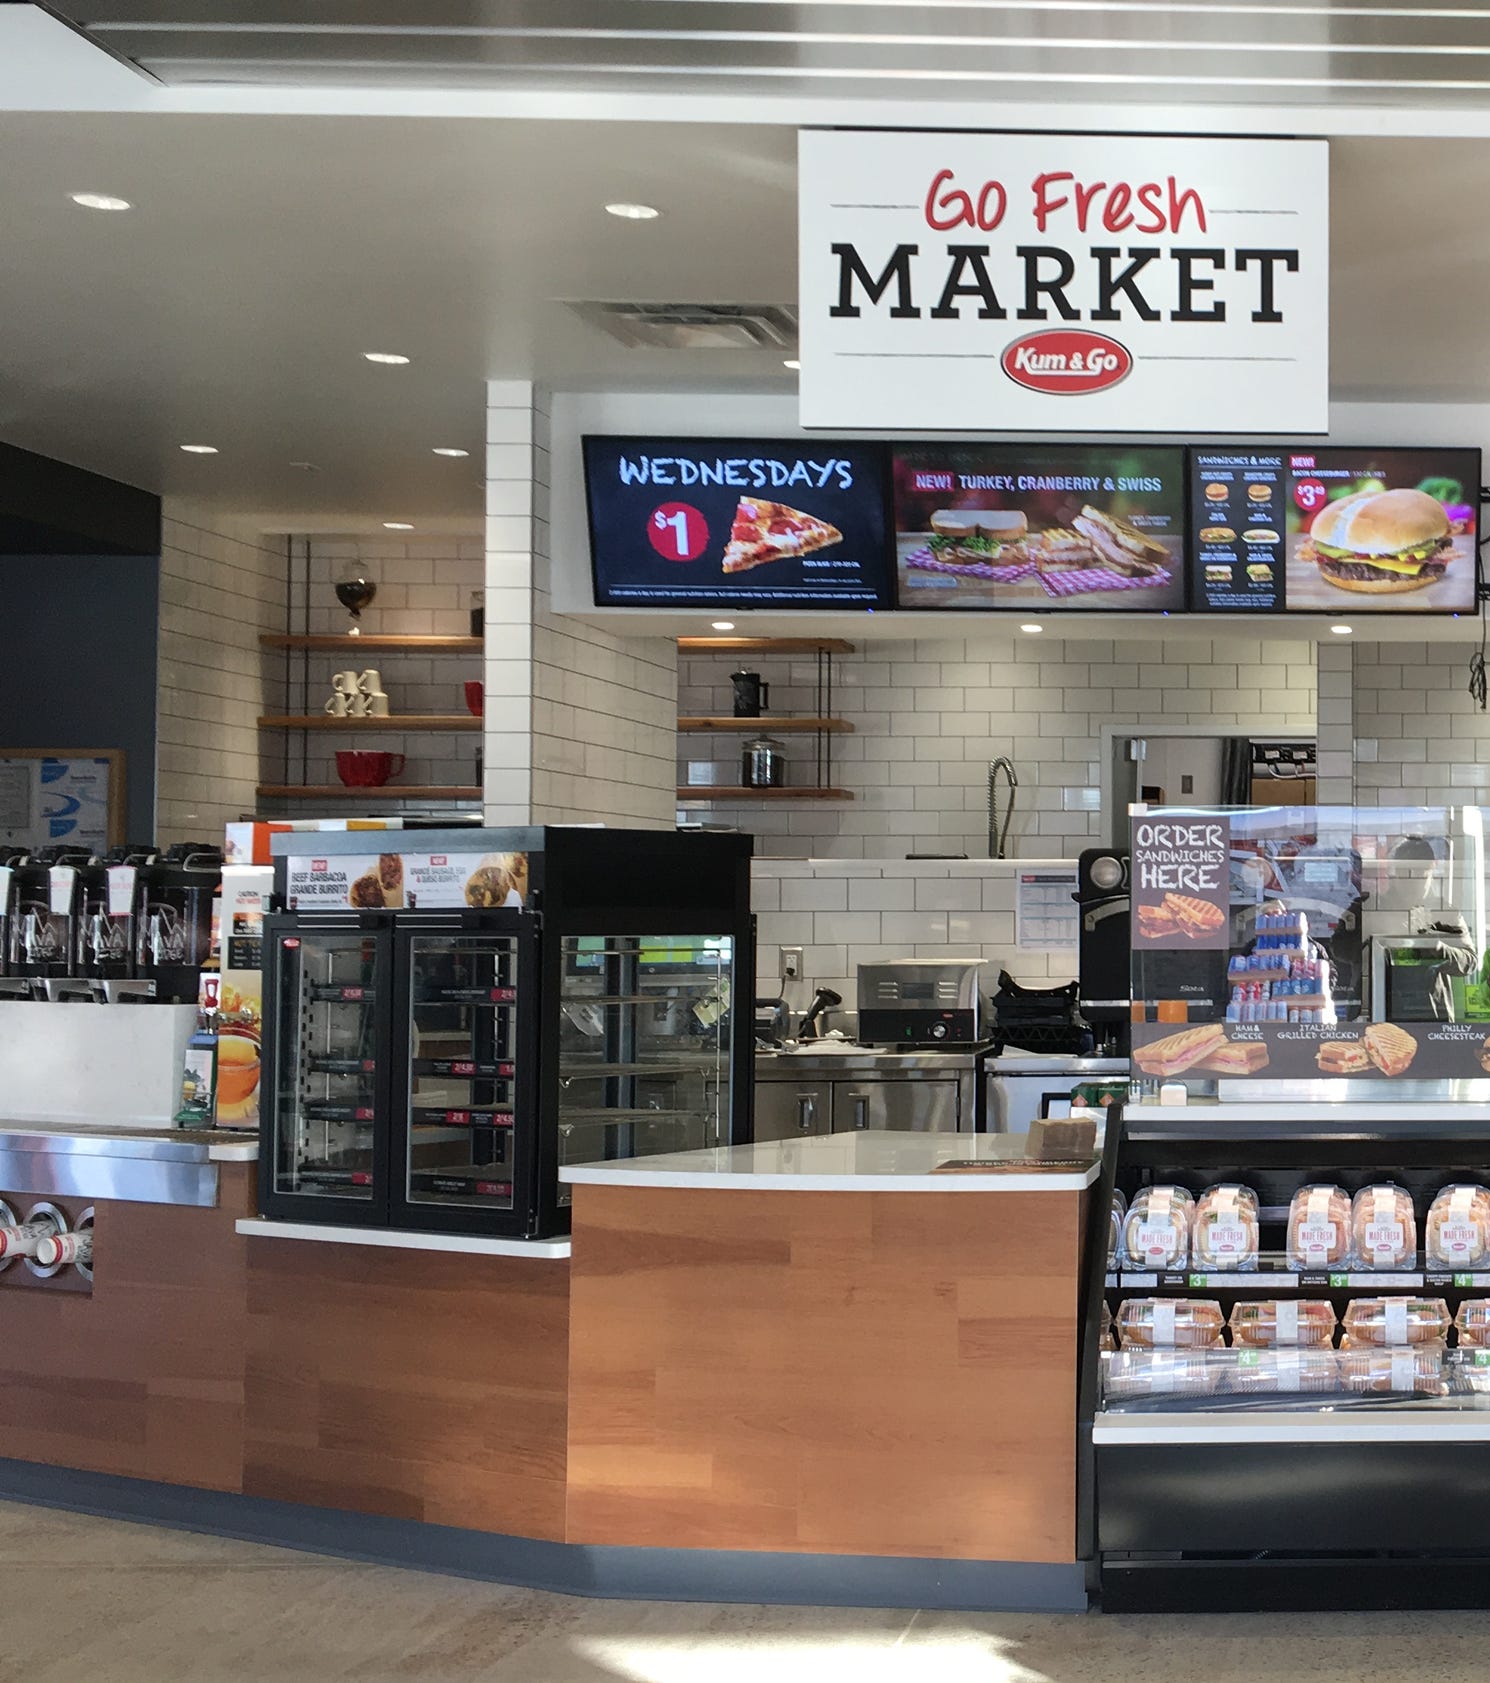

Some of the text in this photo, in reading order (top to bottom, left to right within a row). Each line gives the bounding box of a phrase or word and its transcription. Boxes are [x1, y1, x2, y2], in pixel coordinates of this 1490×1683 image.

[924, 169, 1207, 233] Go Fresh
[830, 242, 1299, 323] MARKET
[1014, 346, 1117, 372] Kum & Go
[618, 455, 853, 489] WEDNESDAYS
[916, 474, 1162, 491] NEW! TURKEY, CRANBERRY & SWISS
[1137, 824, 1224, 849] ORDER
[1136, 850, 1225, 863] SANDWICHES
[291, 872, 309, 882] BEEF
[1141, 864, 1220, 891] HERE
[290, 884, 348, 894] GRANDE BURRITO
[1299, 1024, 1337, 1032] ITALIAN
[1441, 1025, 1472, 1033] PHILLY
[1231, 1032, 1264, 1040] CHEESE
[1277, 1032, 1359, 1040] GRILLED CHICKEN
[1427, 1032, 1486, 1041] CHEESESTEAK
[1142, 1233, 1173, 1244] MADE FRESH
[1211, 1231, 1243, 1241] MADE FRESH
[1301, 1231, 1333, 1241] MADE FRESH
[1368, 1231, 1400, 1241] MADE FRESH
[1443, 1231, 1475, 1241] MADE FRESH
